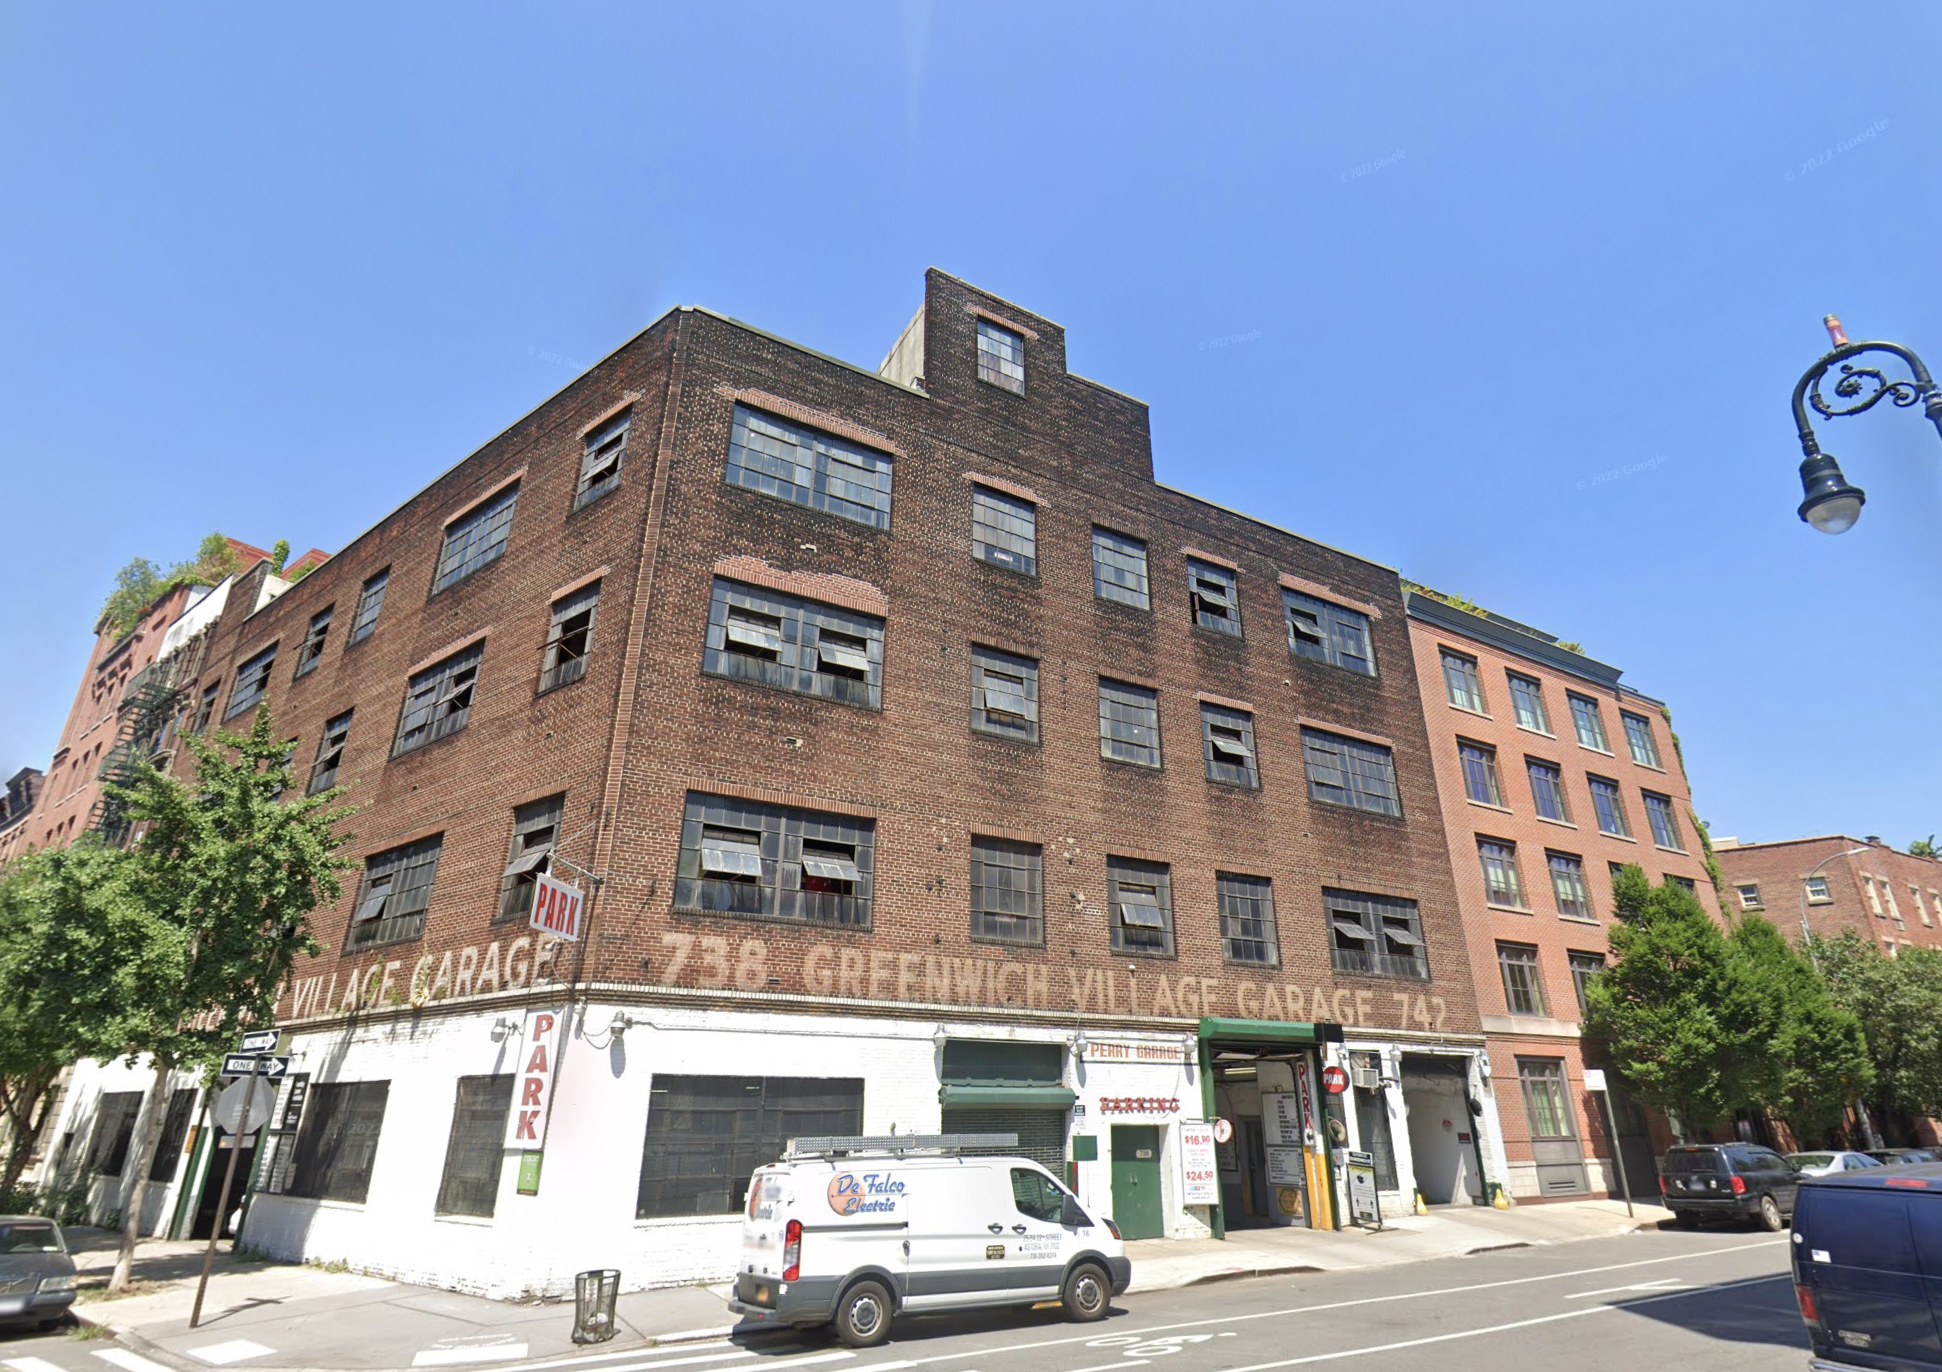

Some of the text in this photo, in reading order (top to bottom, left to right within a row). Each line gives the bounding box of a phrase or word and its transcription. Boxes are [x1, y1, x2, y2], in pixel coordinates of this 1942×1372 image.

[534, 883, 579, 936] PARK
[293, 961, 401, 1020] VILLAGE
[410, 934, 566, 1002] GARAGE
[660, 932, 1452, 1032] 738 GREENWICH VILLAGE GARAGE 742
[1090, 1043, 1130, 1058] PERRY
[1137, 1045, 1181, 1060] GARAGE
[232, 1061, 279, 1071] ONE WAY
[515, 1014, 554, 1140] PARK
[1323, 1073, 1344, 1085] PARK
[1099, 1097, 1180, 1113] PARKING
[1298, 1064, 1313, 1129] PARK
[1185, 1135, 1210, 1145] $16.90
[836, 1173, 905, 1194] De Falco
[1186, 1171, 1213, 1181] $24.50
[843, 1198, 896, 1213] Electric
